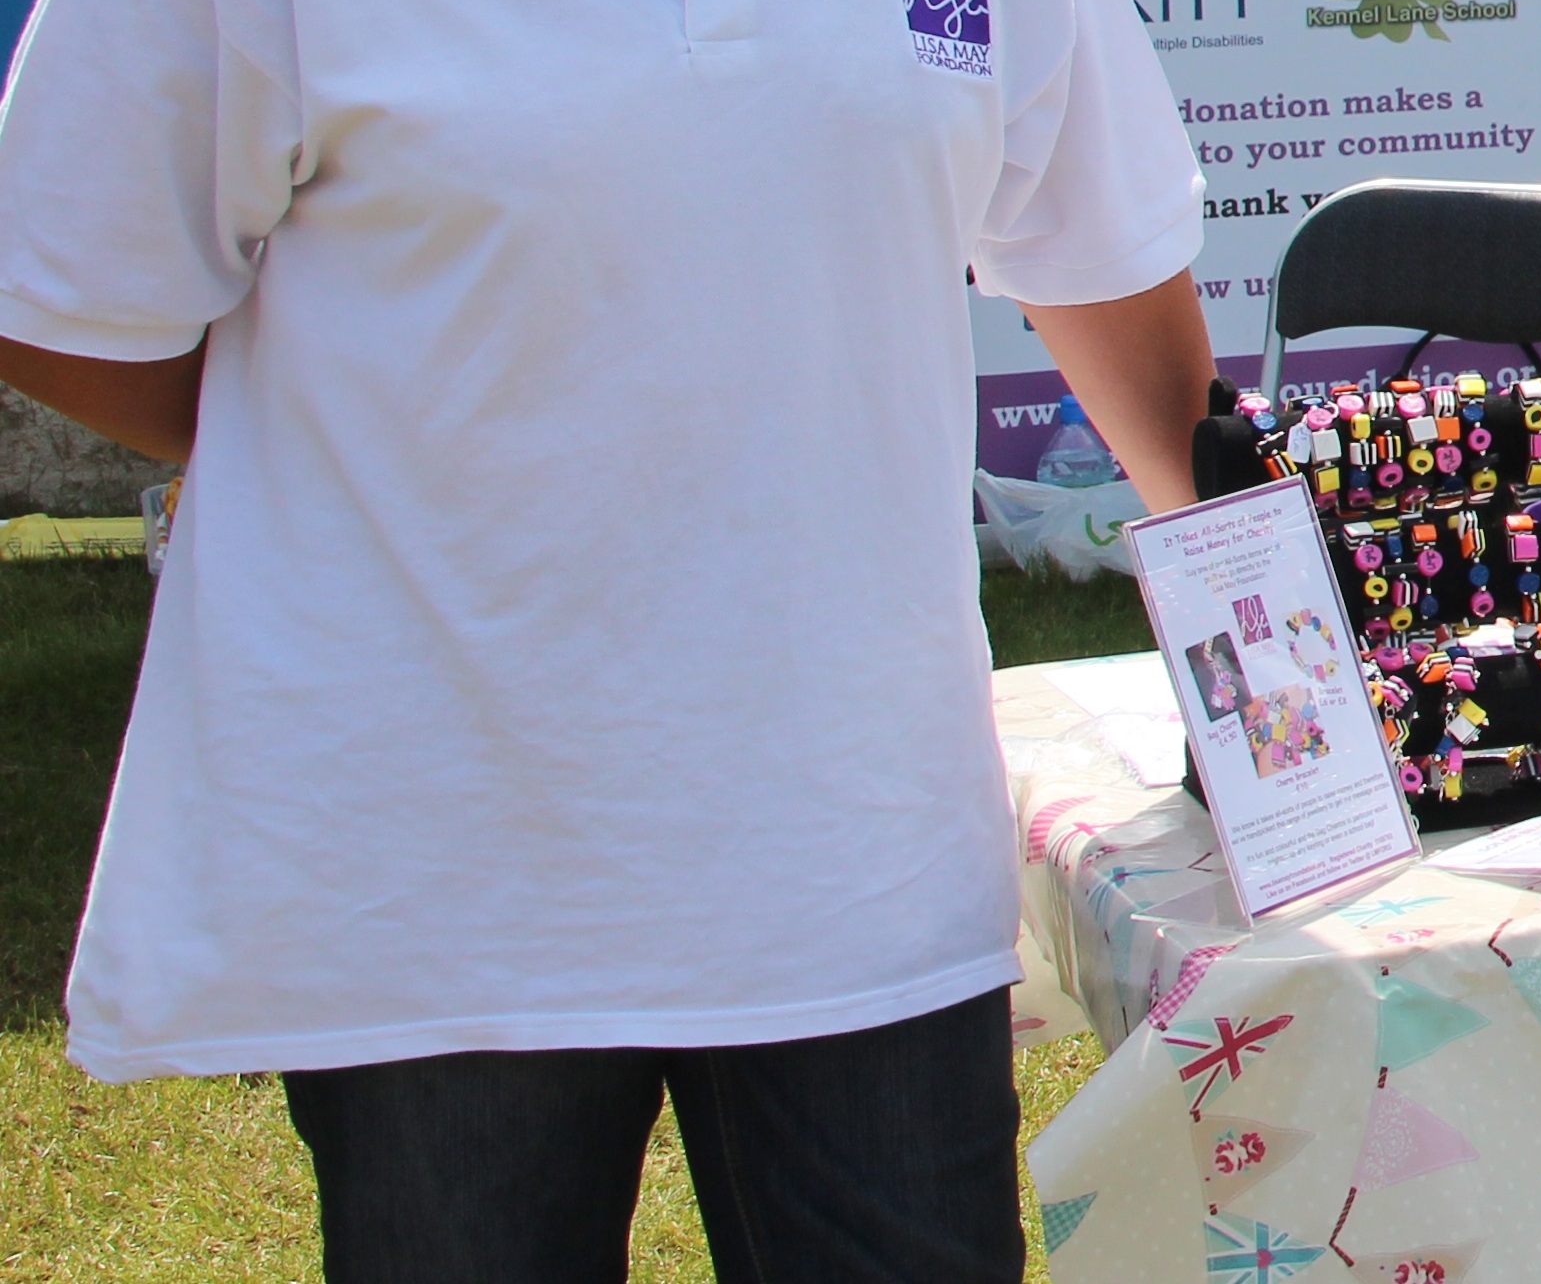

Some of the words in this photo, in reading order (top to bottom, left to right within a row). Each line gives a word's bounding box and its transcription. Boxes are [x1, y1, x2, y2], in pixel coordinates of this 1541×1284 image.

[1307, 6, 1380, 27] Kennel
[1387, 4, 1437, 24] Lane
[1443, 0, 1515, 21] School
[913, 34, 948, 57] LISA
[954, 43, 990, 63] MAY
[1192, 34, 1264, 48] Disabilities
[918, 52, 992, 76] FOUNDATION
[1178, 94, 1330, 123] donation
[1343, 88, 1453, 116] makes
[1465, 91, 1484, 108] a
[1198, 141, 1233, 164] to
[1246, 136, 1326, 169] your
[1338, 125, 1534, 156] community
[1162, 536, 1173, 548] It
[1174, 529, 1198, 544] Takes
[1199, 518, 1236, 537] All-Sorts
[1236, 515, 1245, 527] of
[1272, 505, 1283, 516] to
[1182, 542, 1204, 557] Raise
[1205, 535, 1231, 552] Money
[1231, 531, 1245, 543] for
[1275, 774, 1294, 788] Charm
[1294, 765, 1319, 780] Bracelet
